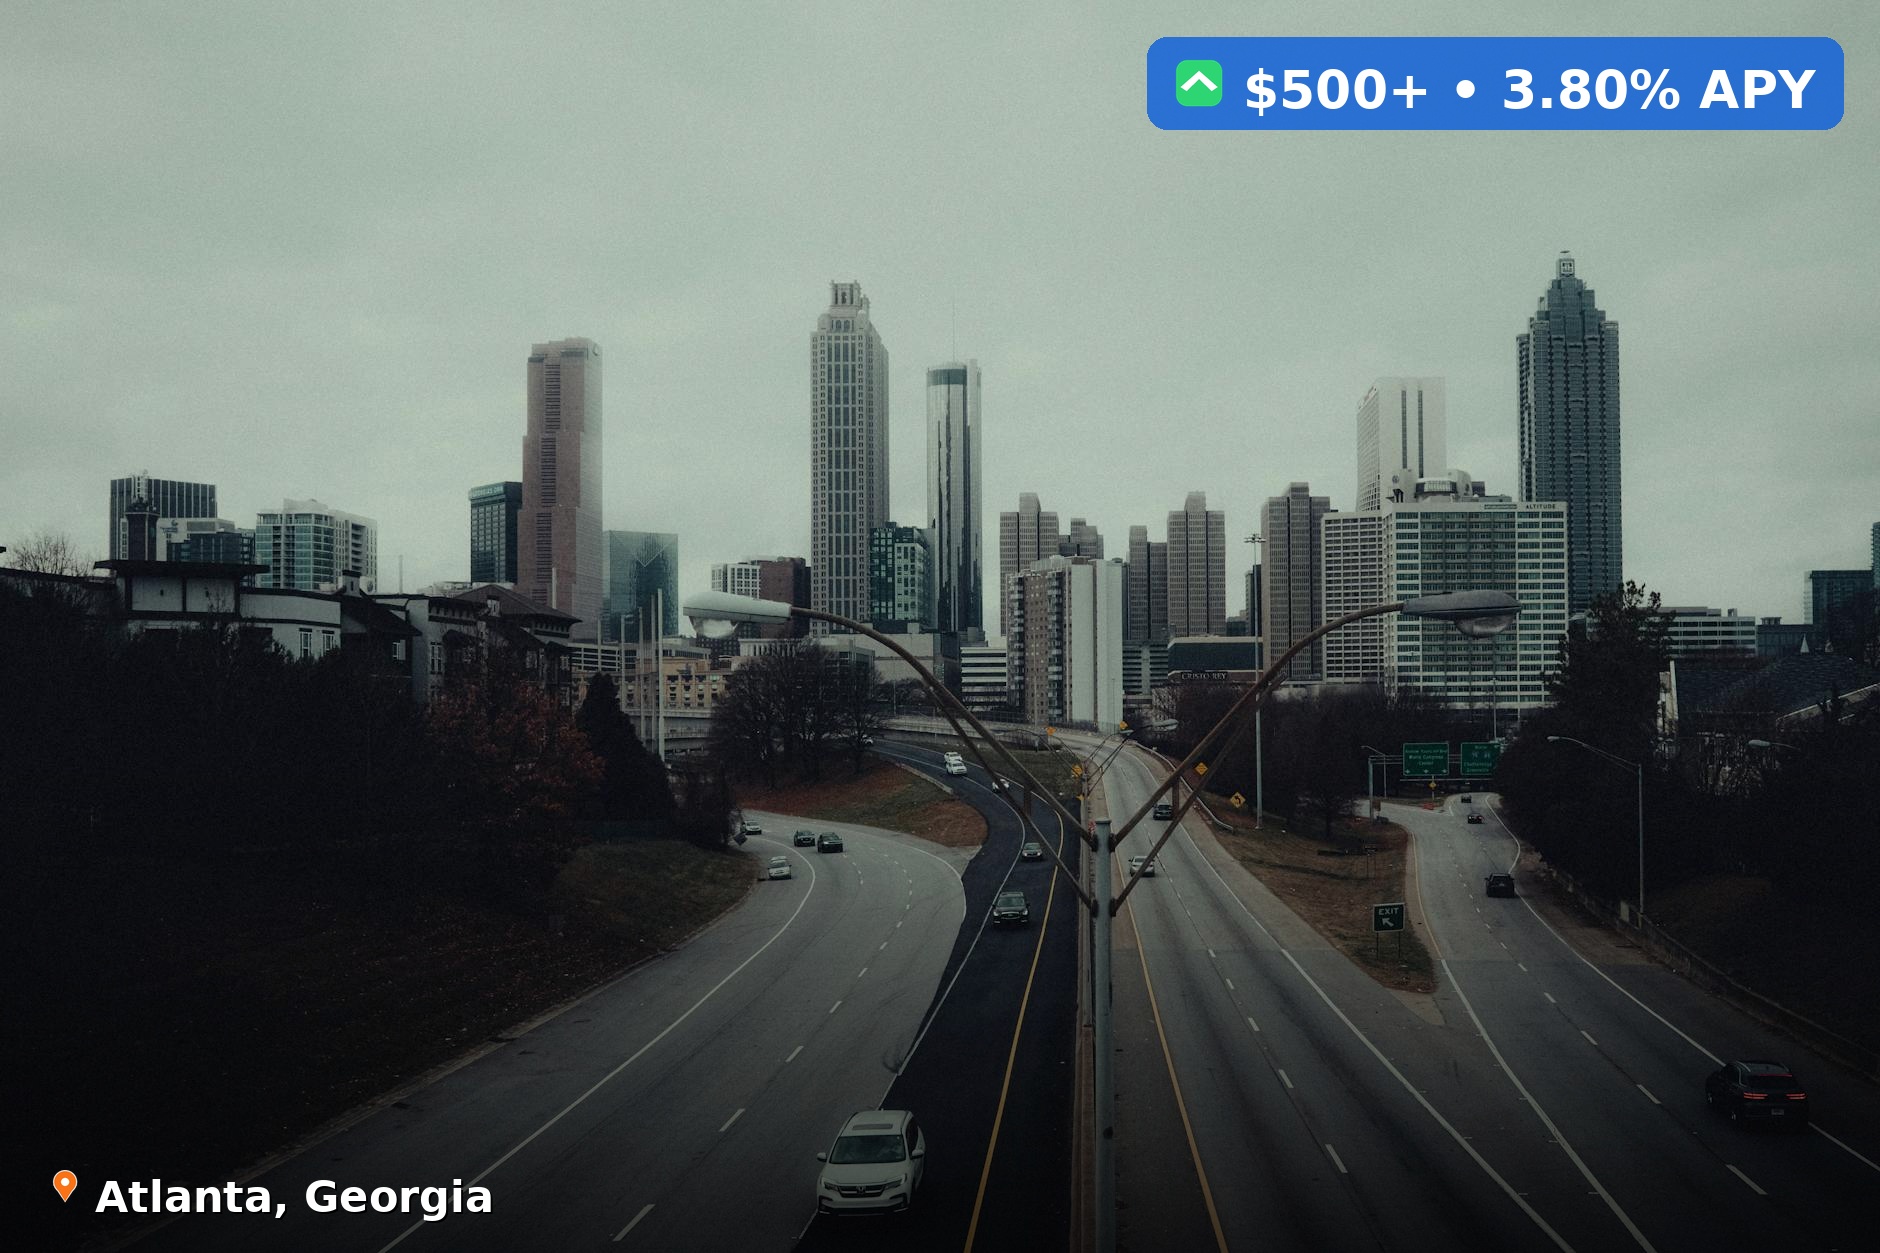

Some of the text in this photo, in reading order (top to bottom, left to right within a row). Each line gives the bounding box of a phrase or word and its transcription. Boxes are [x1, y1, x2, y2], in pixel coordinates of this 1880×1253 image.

[1181, 672, 1227, 680] CRISTO REY
[1378, 907, 1399, 916] EXIT
